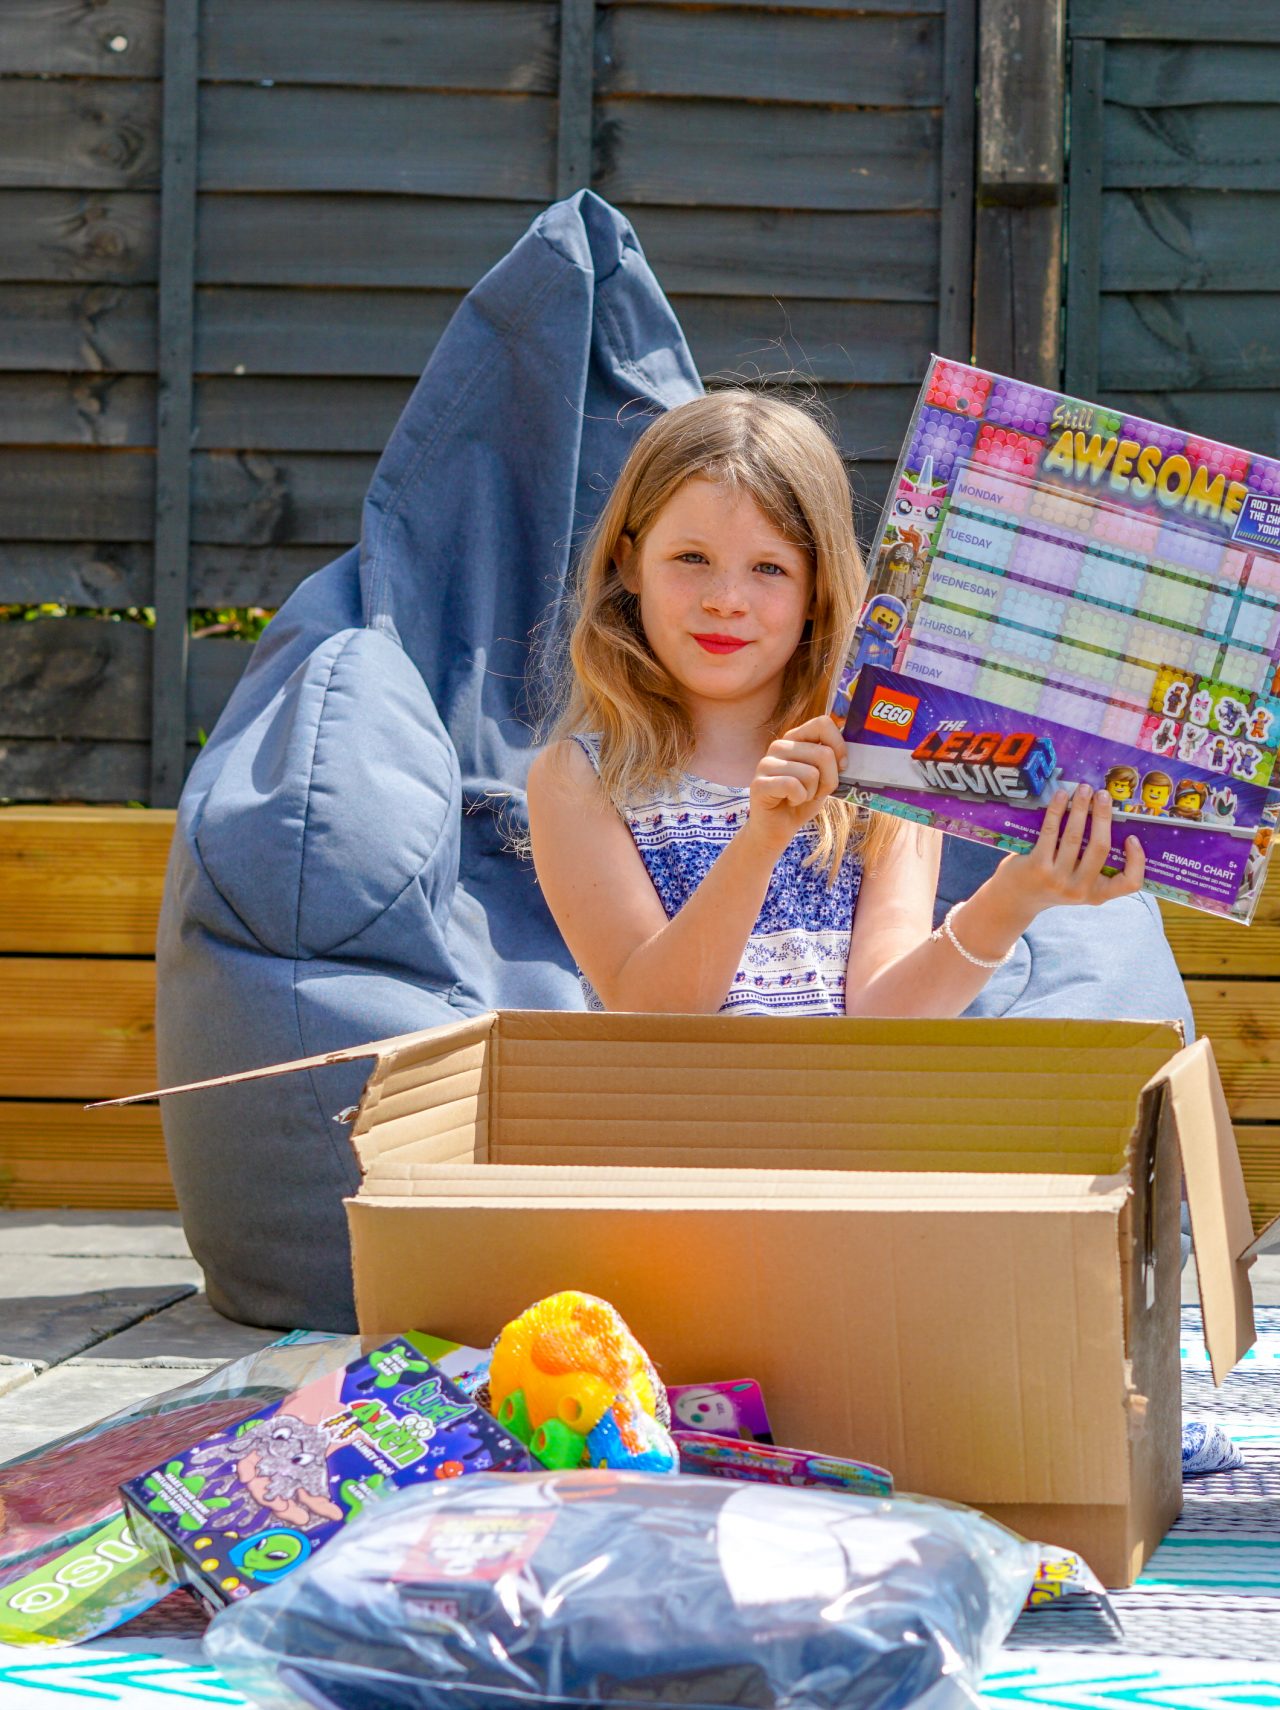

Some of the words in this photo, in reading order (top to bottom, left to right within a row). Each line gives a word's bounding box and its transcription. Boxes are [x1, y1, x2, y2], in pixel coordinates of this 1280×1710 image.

[1051, 405, 1094, 431] Still
[1043, 430, 1249, 525] AWESOME
[958, 483, 1004, 504] MONDAY
[1250, 499, 1268, 511] ADD
[1249, 510, 1265, 522] THE
[945, 527, 992, 549] TUESDAY
[1257, 523, 1279, 536] YOUR
[932, 571, 998, 599] WEDNESDAY
[919, 616, 974, 640] THURSDAY
[905, 661, 943, 679] FRIDAY
[872, 701, 913, 725] LEGO
[936, 720, 968, 732] THE
[911, 732, 1036, 767] LEGO
[912, 760, 1029, 799] MOVIE
[1162, 851, 1202, 870] REWARD
[1203, 864, 1236, 880] CHART
[1228, 861, 1238, 869] 5+
